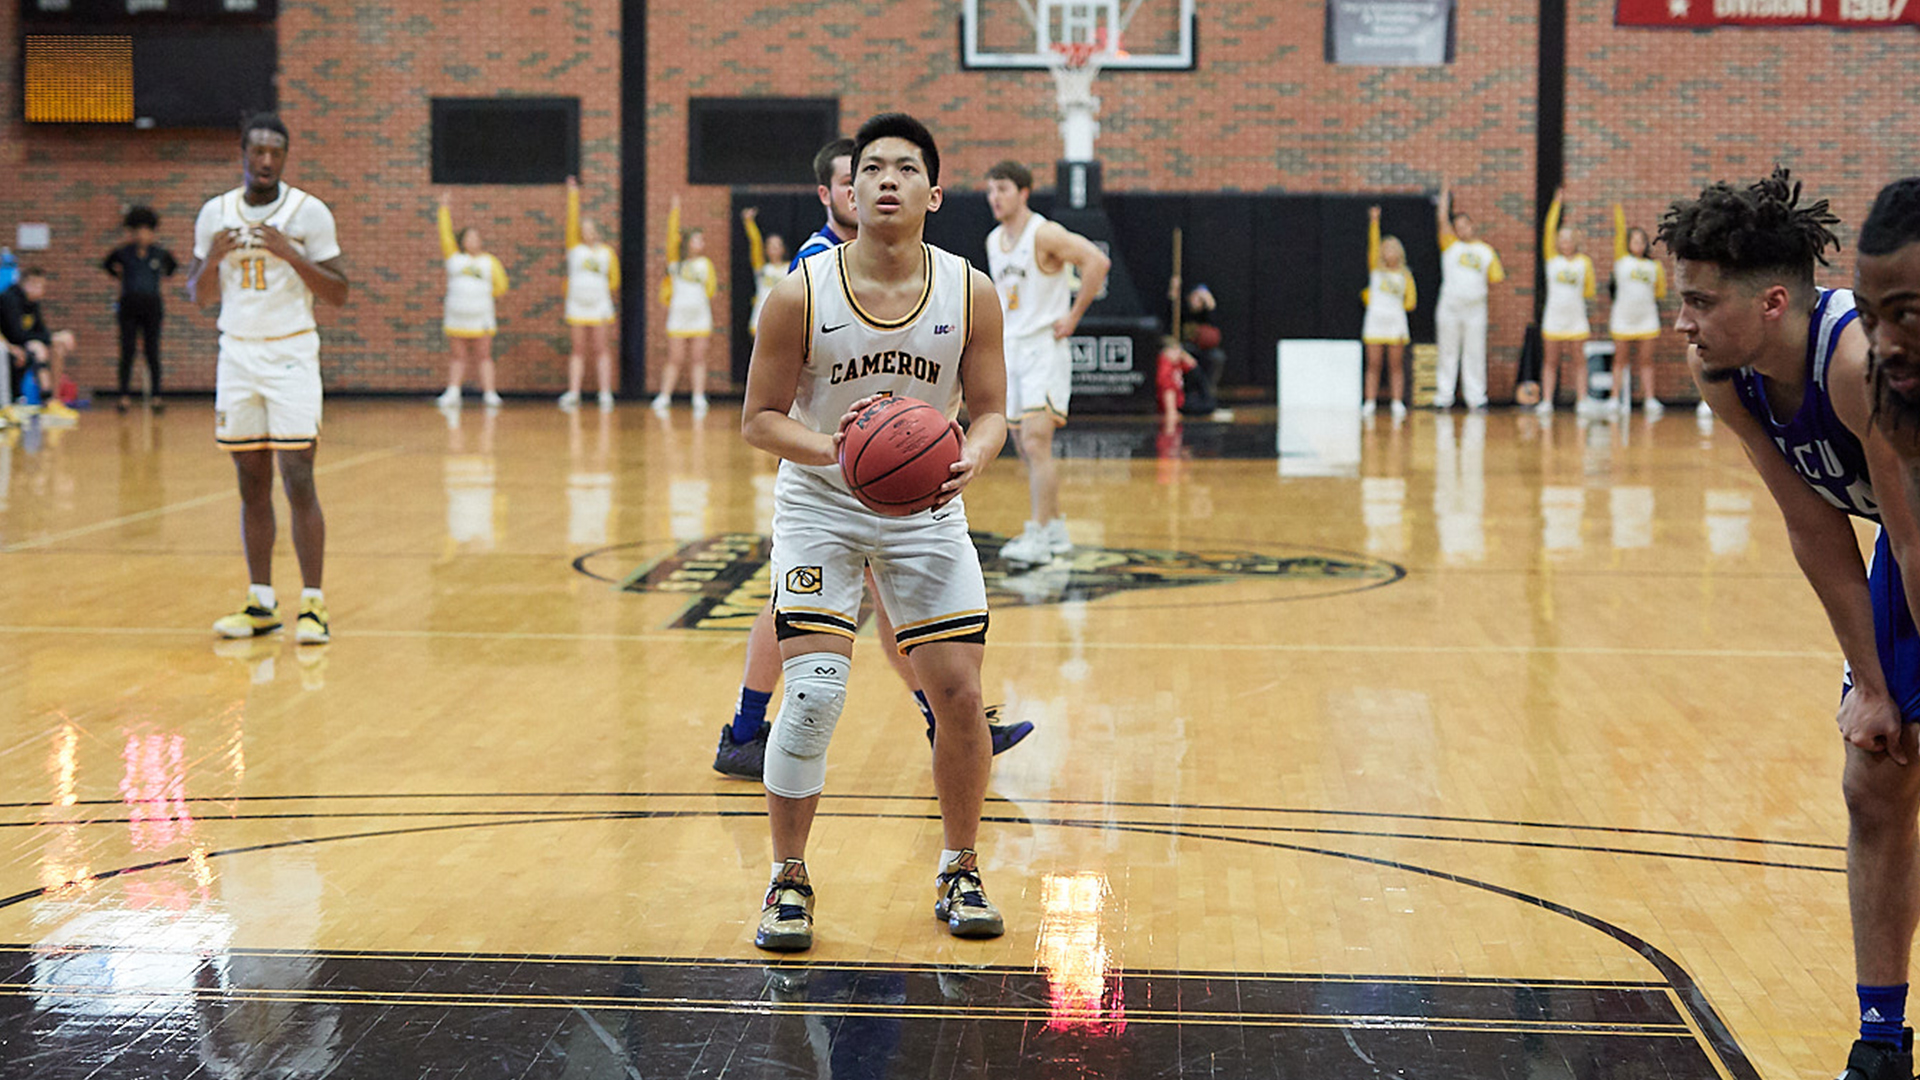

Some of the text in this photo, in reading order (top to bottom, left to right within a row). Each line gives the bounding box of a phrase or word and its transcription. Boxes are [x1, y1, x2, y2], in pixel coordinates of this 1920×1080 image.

[1839, 0, 1909, 20] 1987
[240, 258, 267, 291] 11
[830, 350, 942, 386] CAMERON
